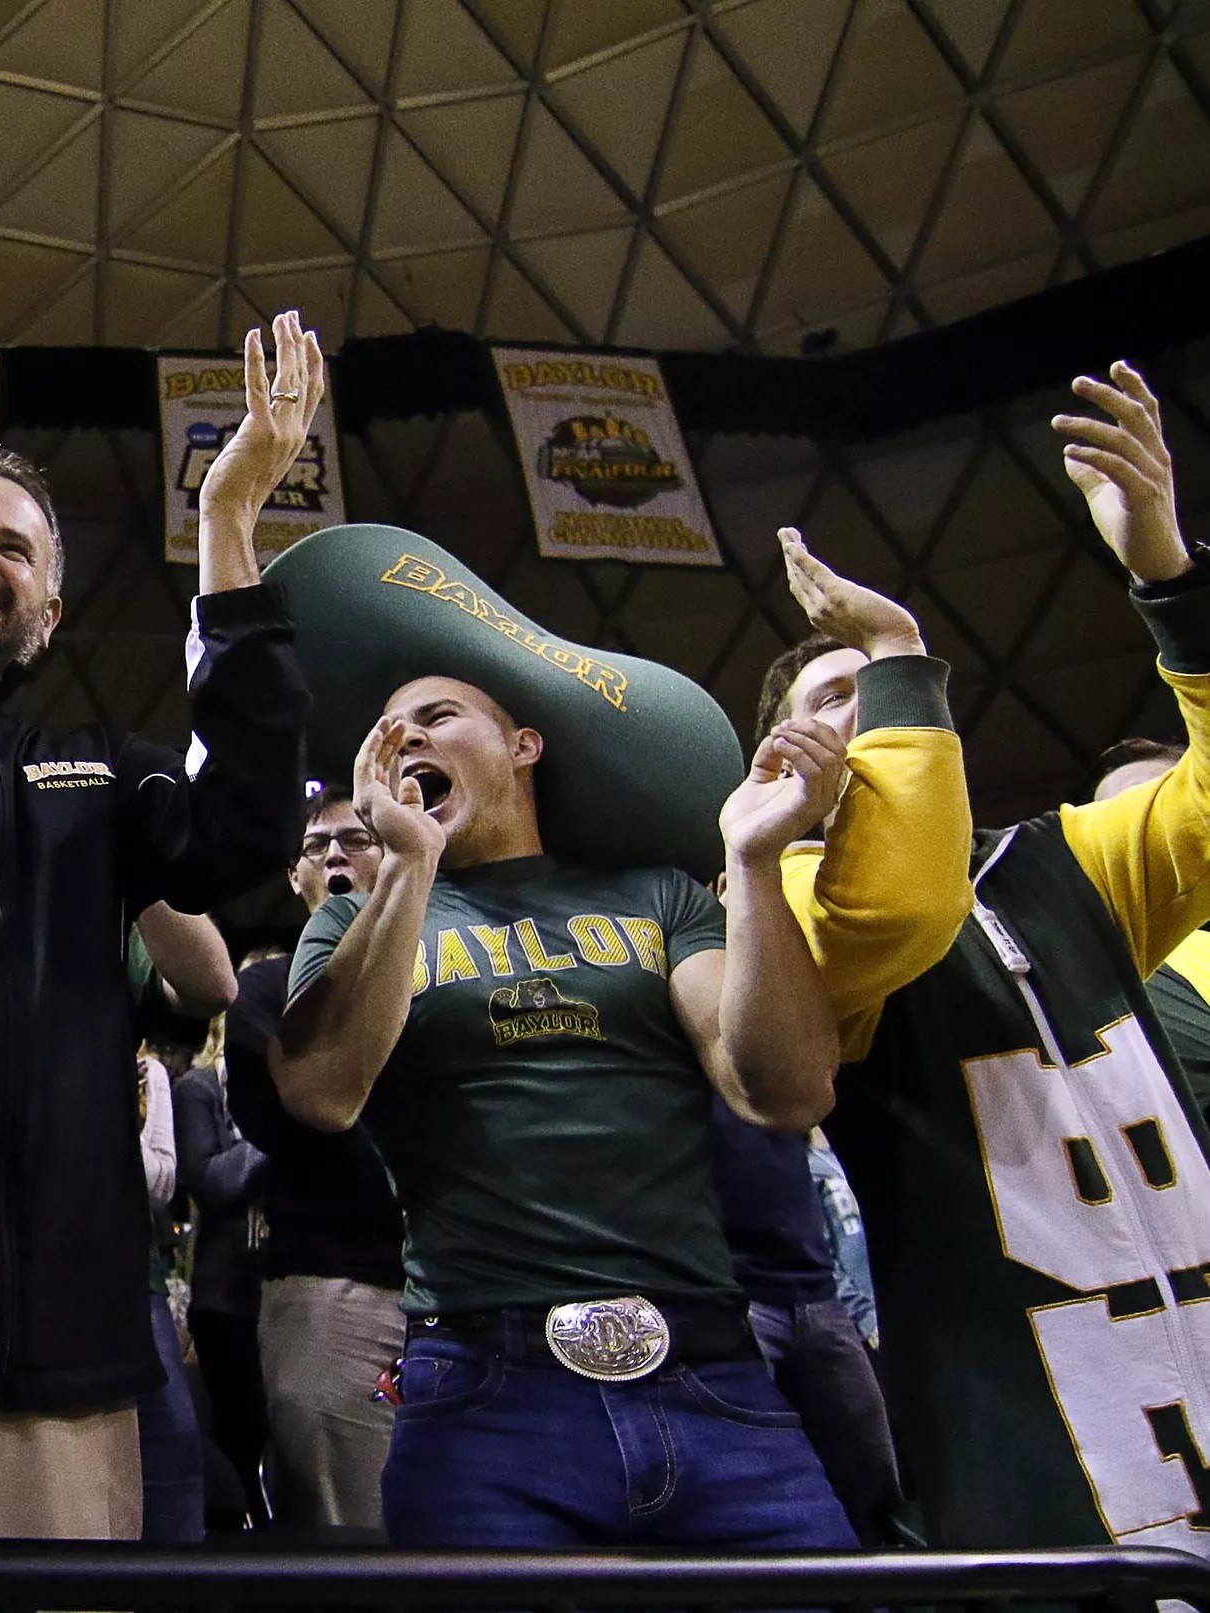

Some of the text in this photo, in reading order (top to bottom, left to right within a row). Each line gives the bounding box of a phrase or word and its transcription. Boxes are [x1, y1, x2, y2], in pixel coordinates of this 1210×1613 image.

[504, 362, 660, 395] BAYLOR
[381, 554, 627, 709] BAYLOR
[22, 761, 116, 782] BAYLOR
[37, 777, 110, 790] BASKETBALL
[493, 1009, 603, 1046] BAYLOR
